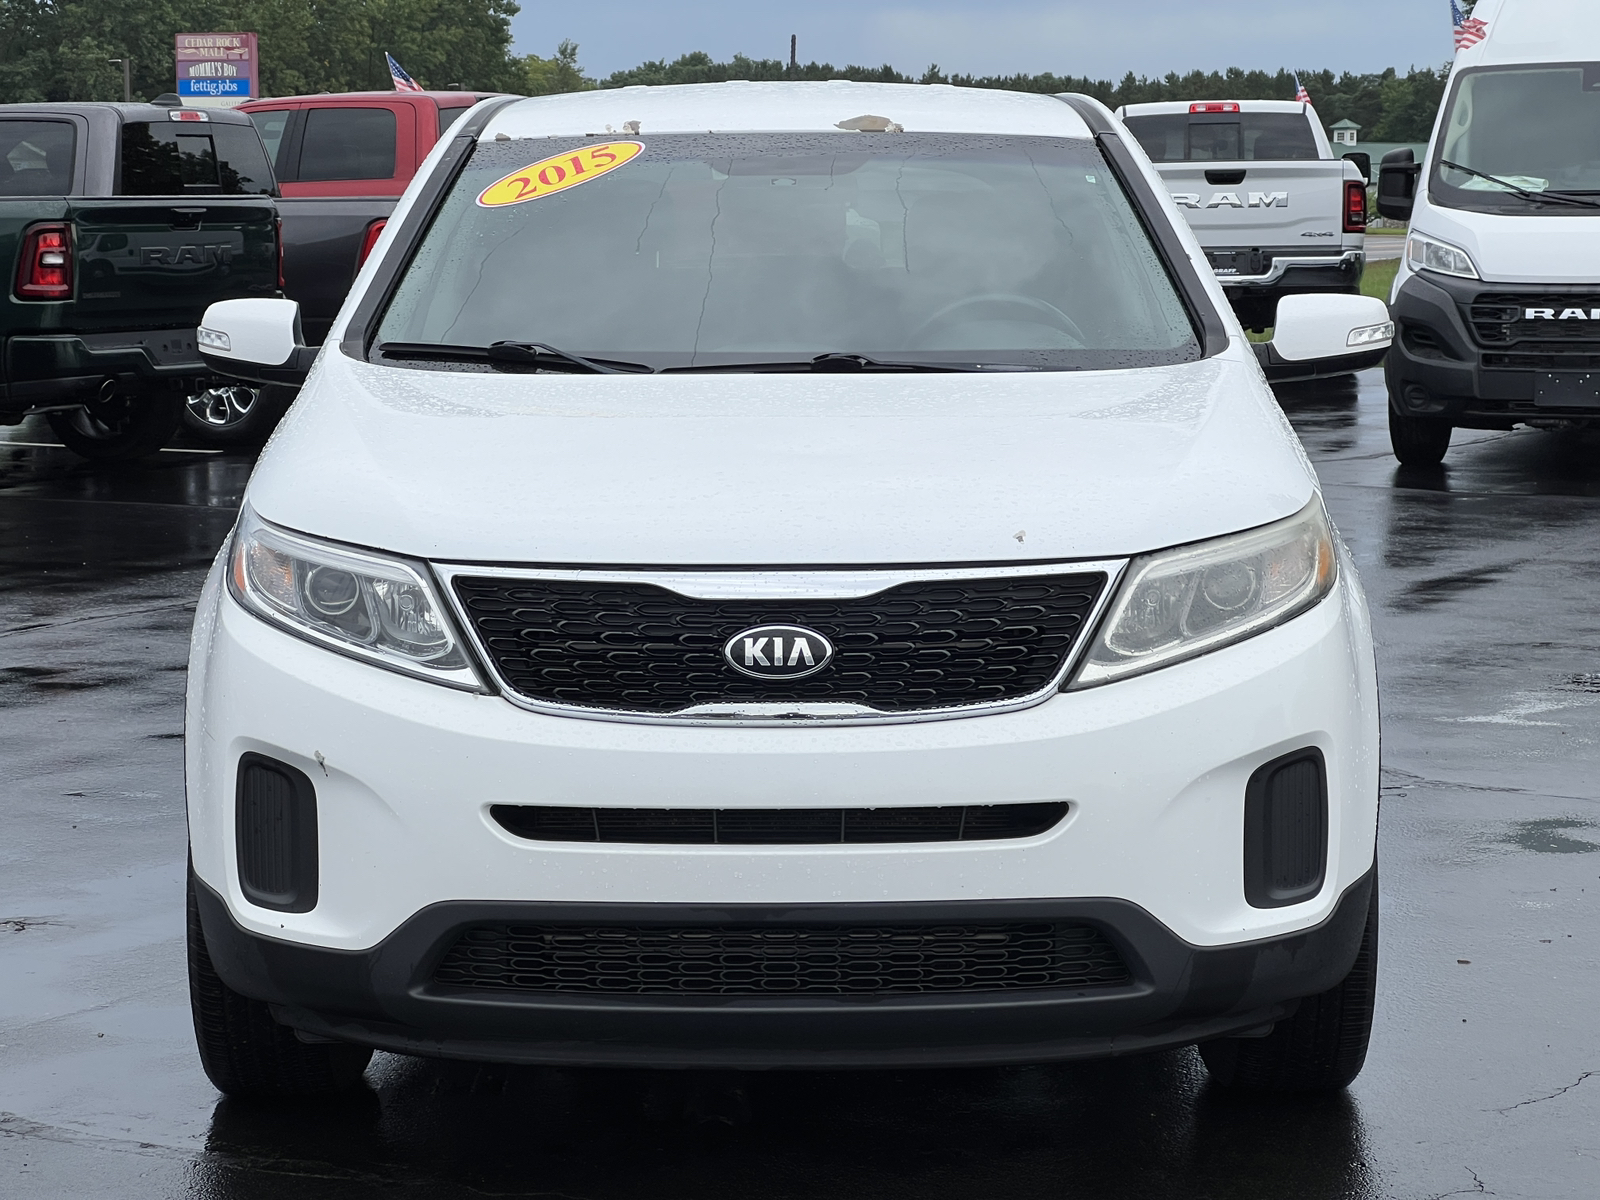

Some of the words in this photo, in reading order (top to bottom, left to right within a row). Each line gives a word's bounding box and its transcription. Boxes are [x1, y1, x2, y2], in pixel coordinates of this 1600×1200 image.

[185, 38, 213, 47] CEDAR
[216, 38, 240, 47] ROCK
[200, 48, 225, 57] MALL
[189, 61, 222, 77] MOMMA'S
[223, 62, 237, 77] BOY
[190, 79, 238, 95] fettig.jobs
[507, 145, 617, 200] 2015
[1170, 192, 1289, 209] RAM
[140, 245, 232, 265] RAM
[1525, 308, 1600, 320] RA
[743, 637, 815, 666] KIA
